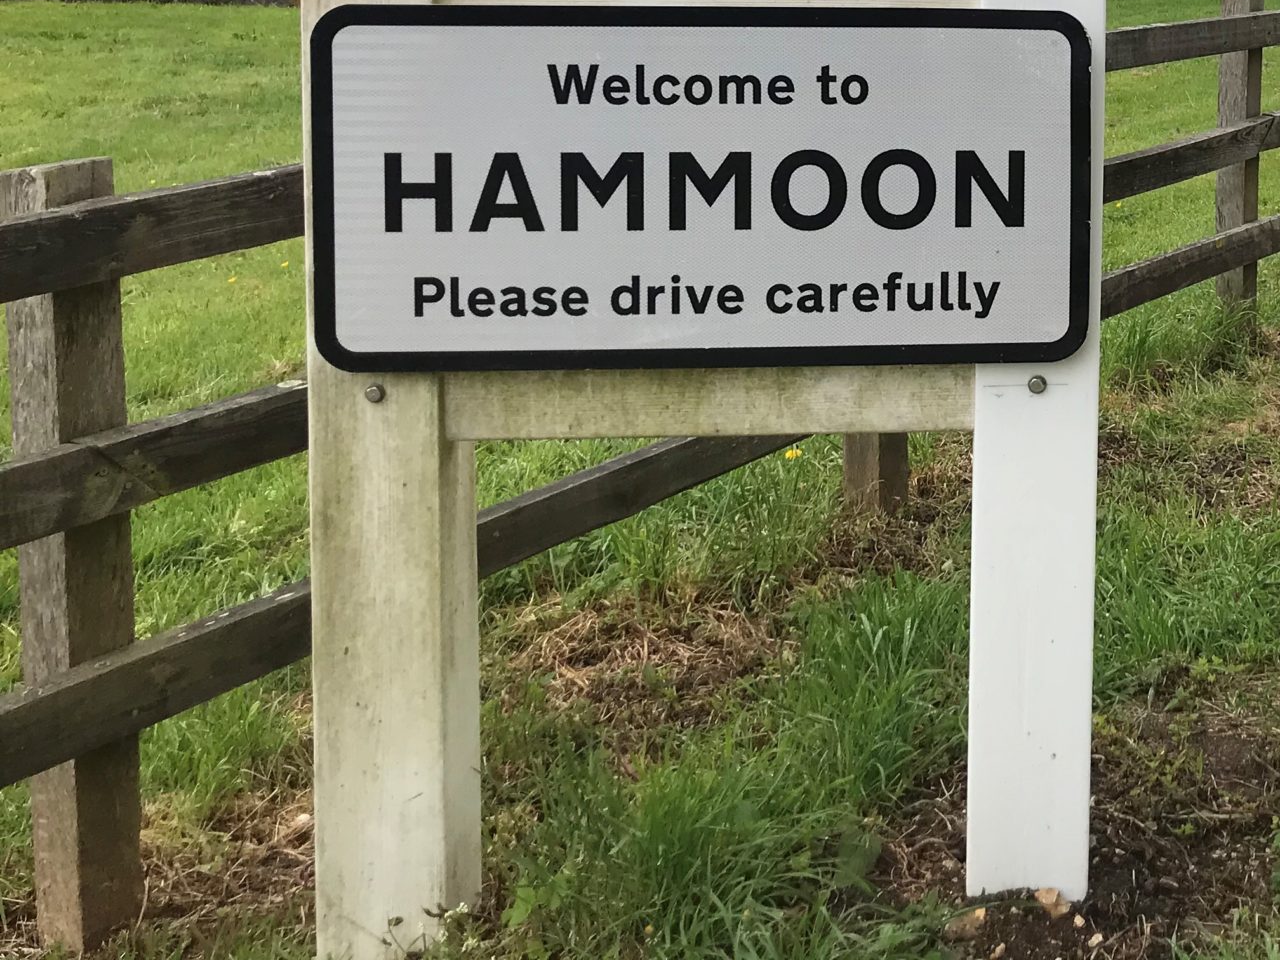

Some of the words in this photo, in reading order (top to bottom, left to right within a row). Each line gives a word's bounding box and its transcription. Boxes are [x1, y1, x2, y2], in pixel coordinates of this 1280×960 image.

[547, 64, 794, 105] Welcome
[816, 65, 869, 105] to
[384, 149, 1025, 232] HAMMOON
[414, 277, 588, 317] Please
[611, 275, 744, 315] drive
[766, 271, 1000, 318] carefully
